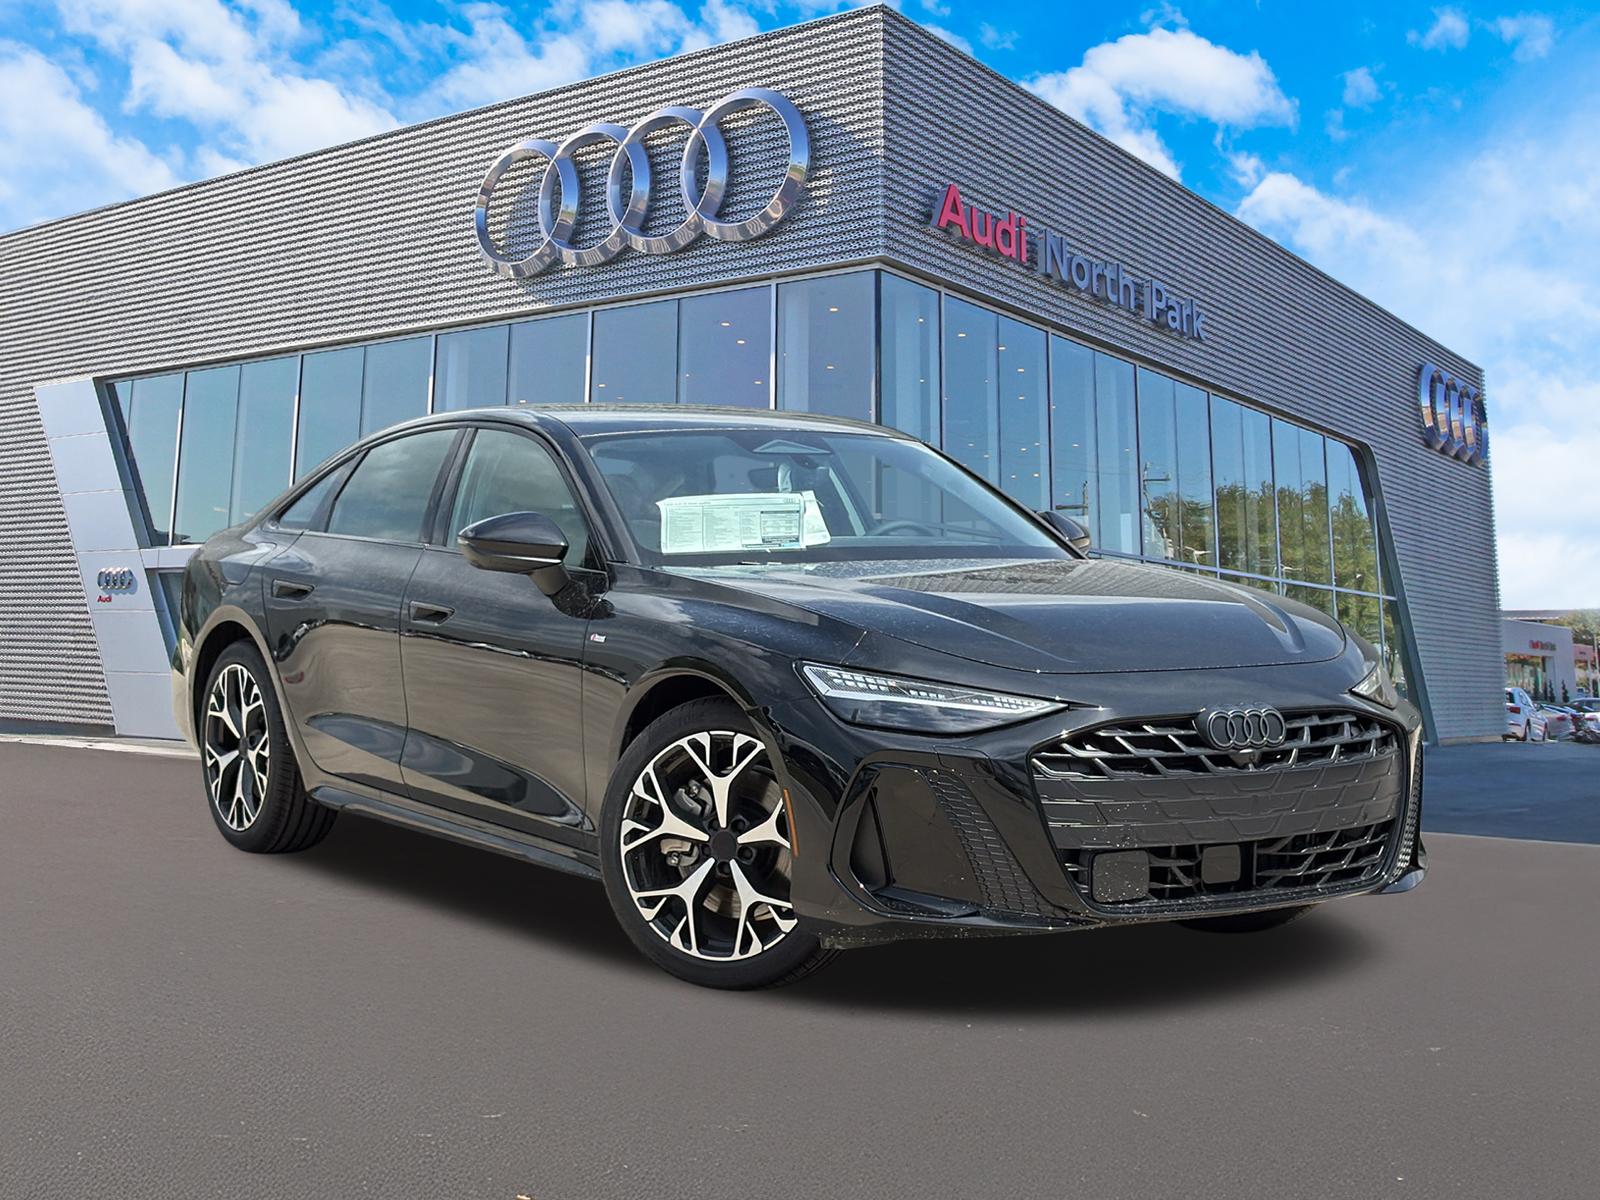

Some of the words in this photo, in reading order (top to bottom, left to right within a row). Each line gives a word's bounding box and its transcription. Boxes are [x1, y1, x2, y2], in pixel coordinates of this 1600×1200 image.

[936, 183, 1028, 265] Audi
[1042, 229, 1138, 311] North
[1148, 278, 1207, 341] Park
[96, 594, 113, 603] Audi
